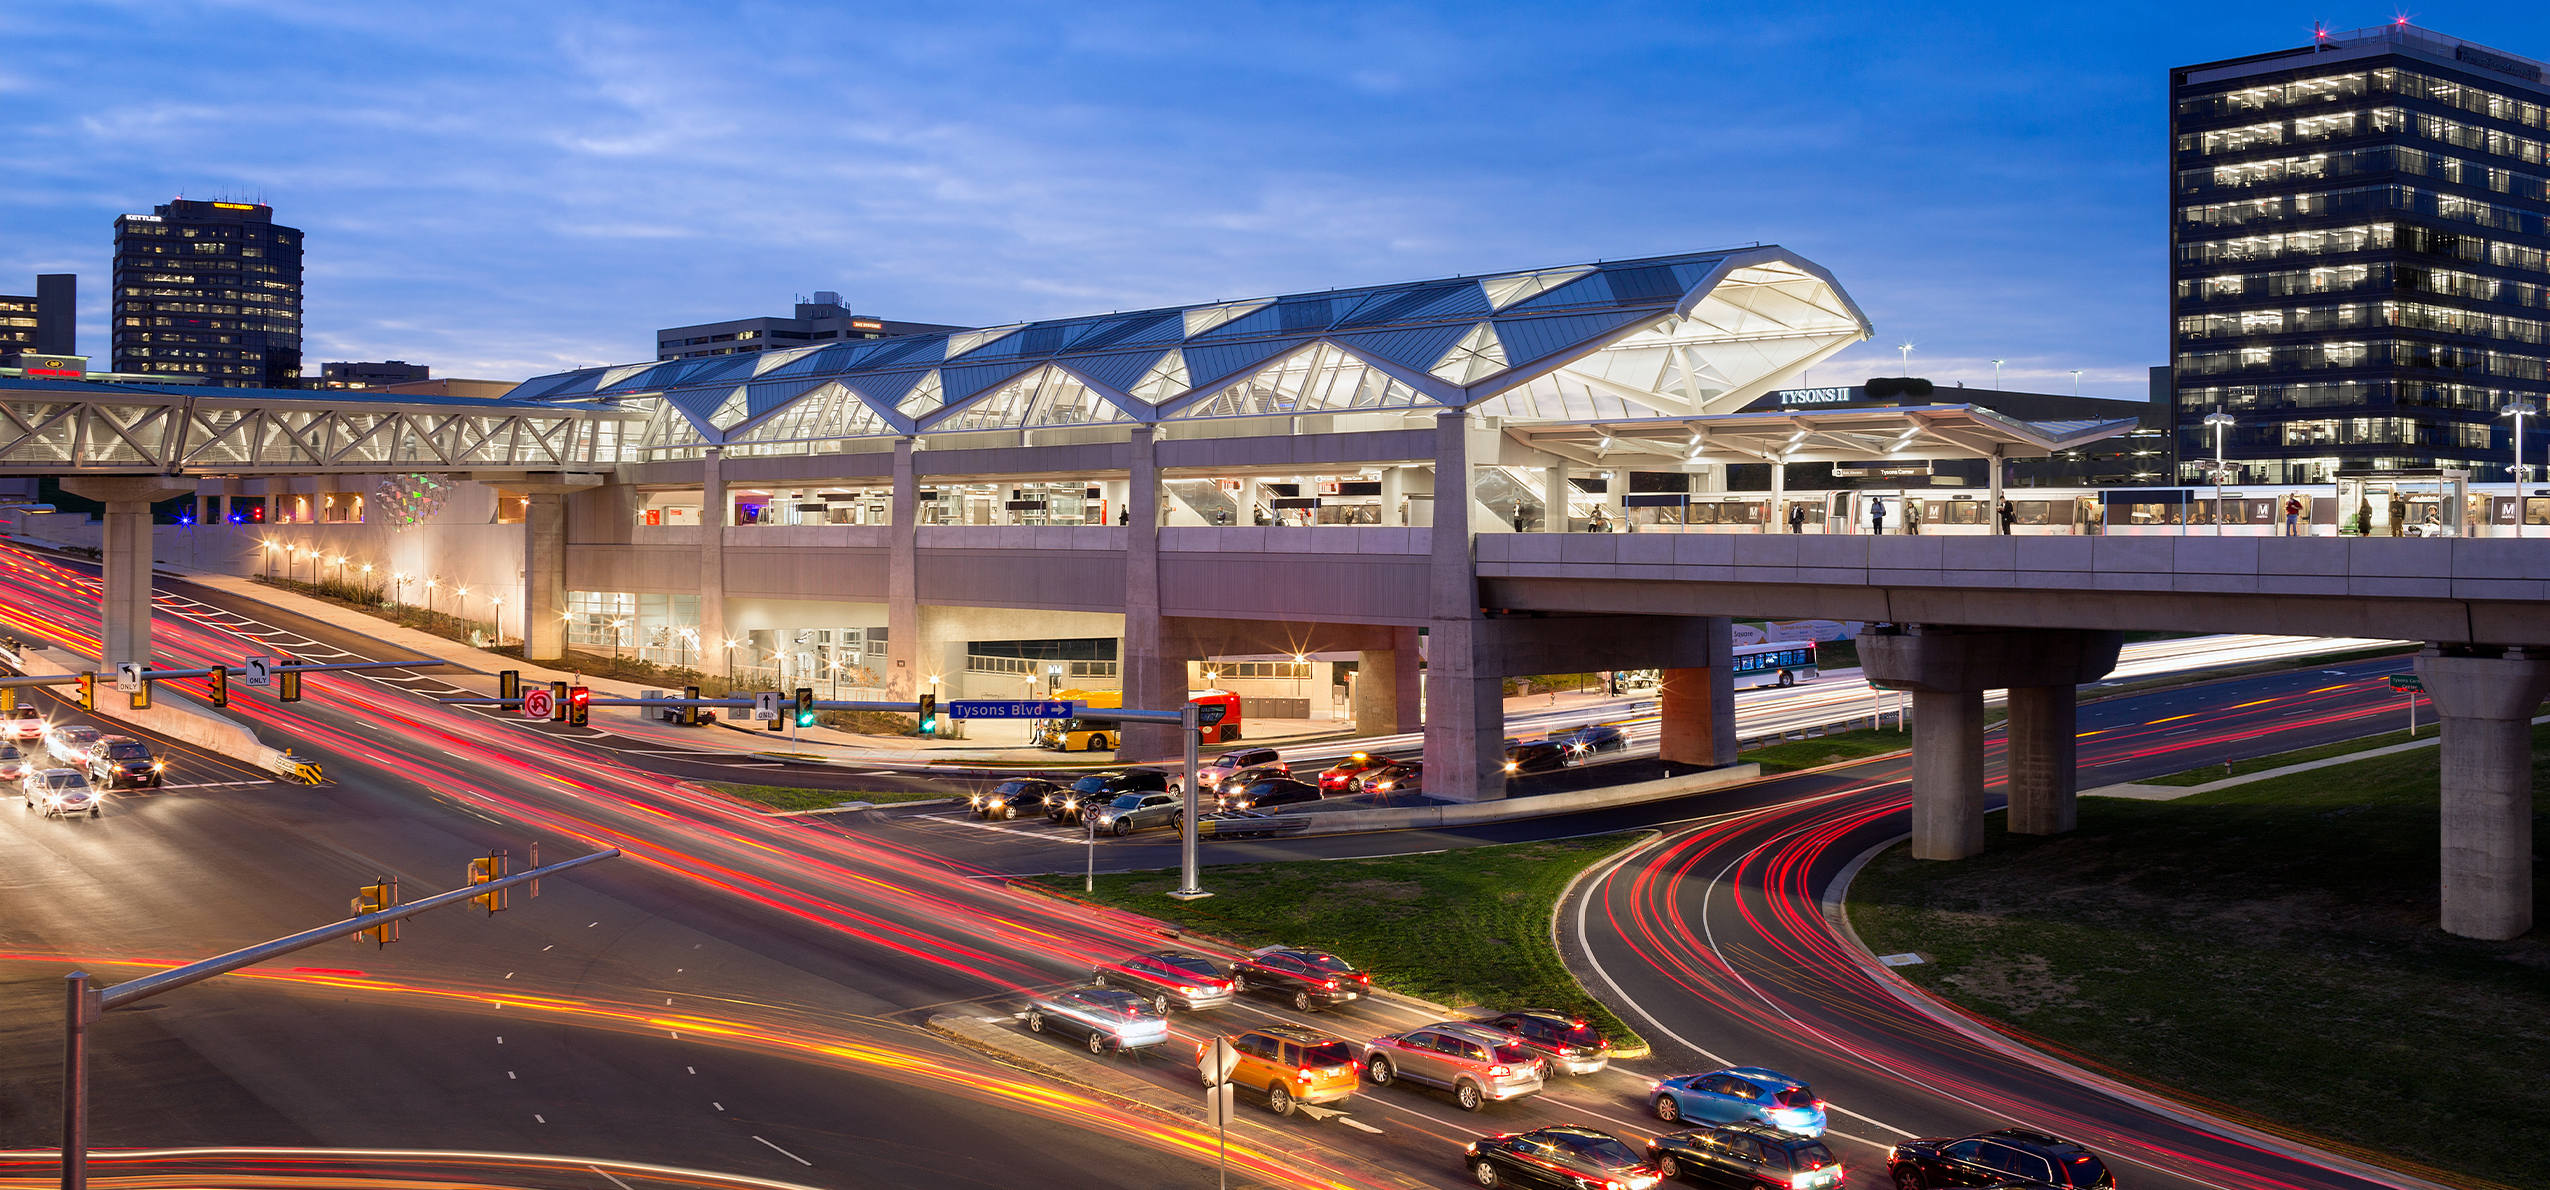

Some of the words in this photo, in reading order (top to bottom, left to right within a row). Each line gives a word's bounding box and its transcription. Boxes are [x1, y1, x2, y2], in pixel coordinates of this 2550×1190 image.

[126, 214, 162, 222] KETTLER
[1779, 388, 1836, 404] TYSONS
[1837, 388, 1850, 402] II
[1929, 505, 1939, 516] M
[2257, 503, 2269, 515] M
[2502, 503, 2515, 515] M
[955, 704, 1005, 718] Tysons
[1011, 704, 1042, 715] Blvd
